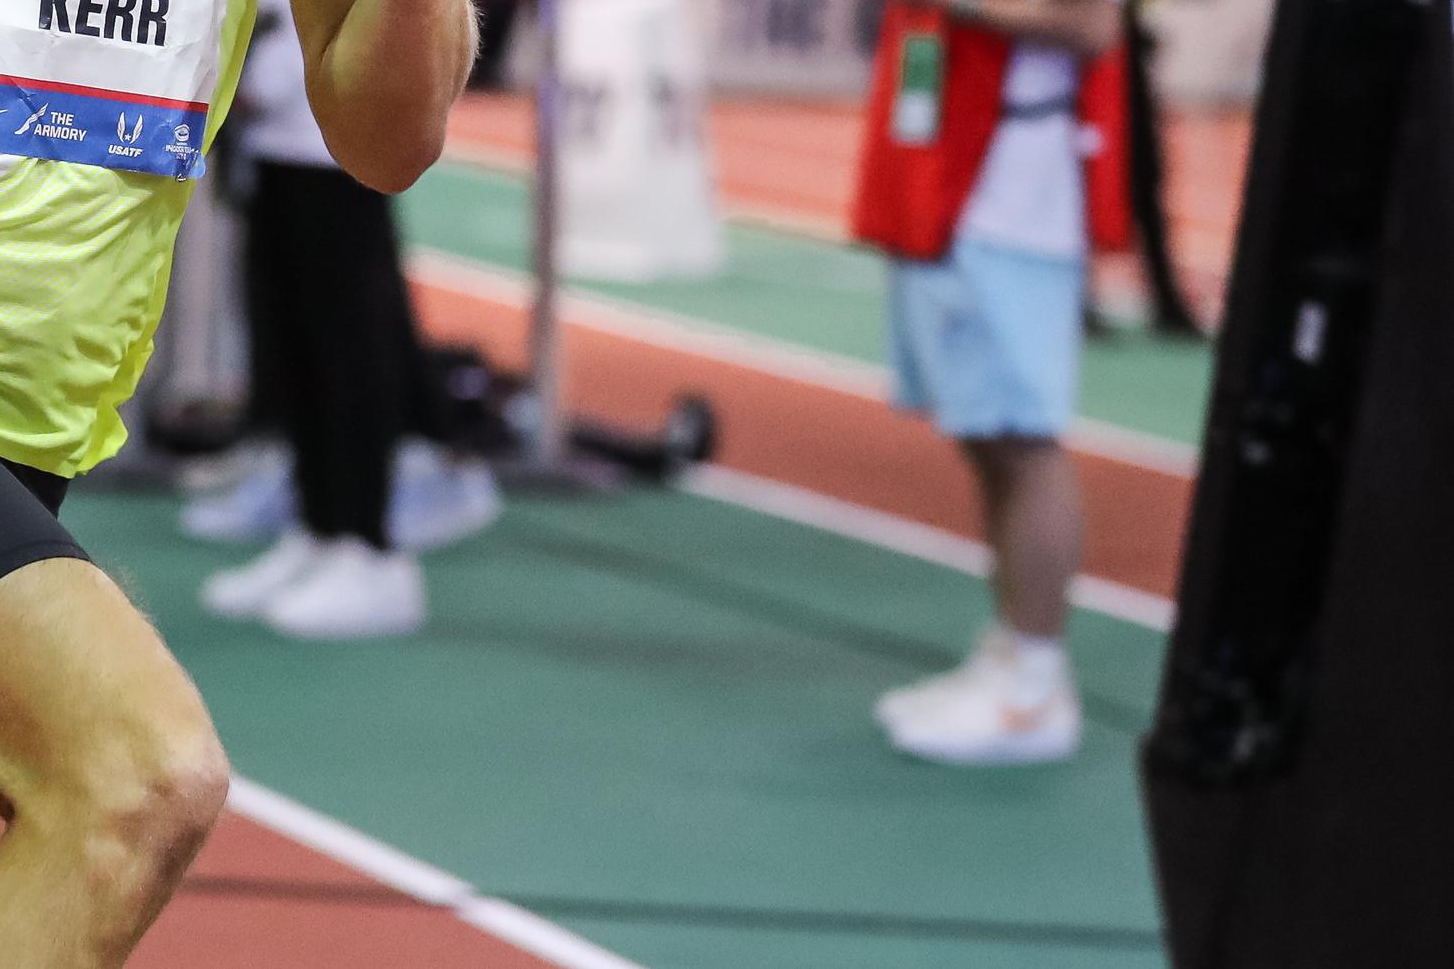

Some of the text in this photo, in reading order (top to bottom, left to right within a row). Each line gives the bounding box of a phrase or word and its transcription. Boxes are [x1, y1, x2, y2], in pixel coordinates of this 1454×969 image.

[51, 112, 74, 126] THE
[34, 124, 87, 141] ARMORY
[108, 144, 143, 157] USATF
